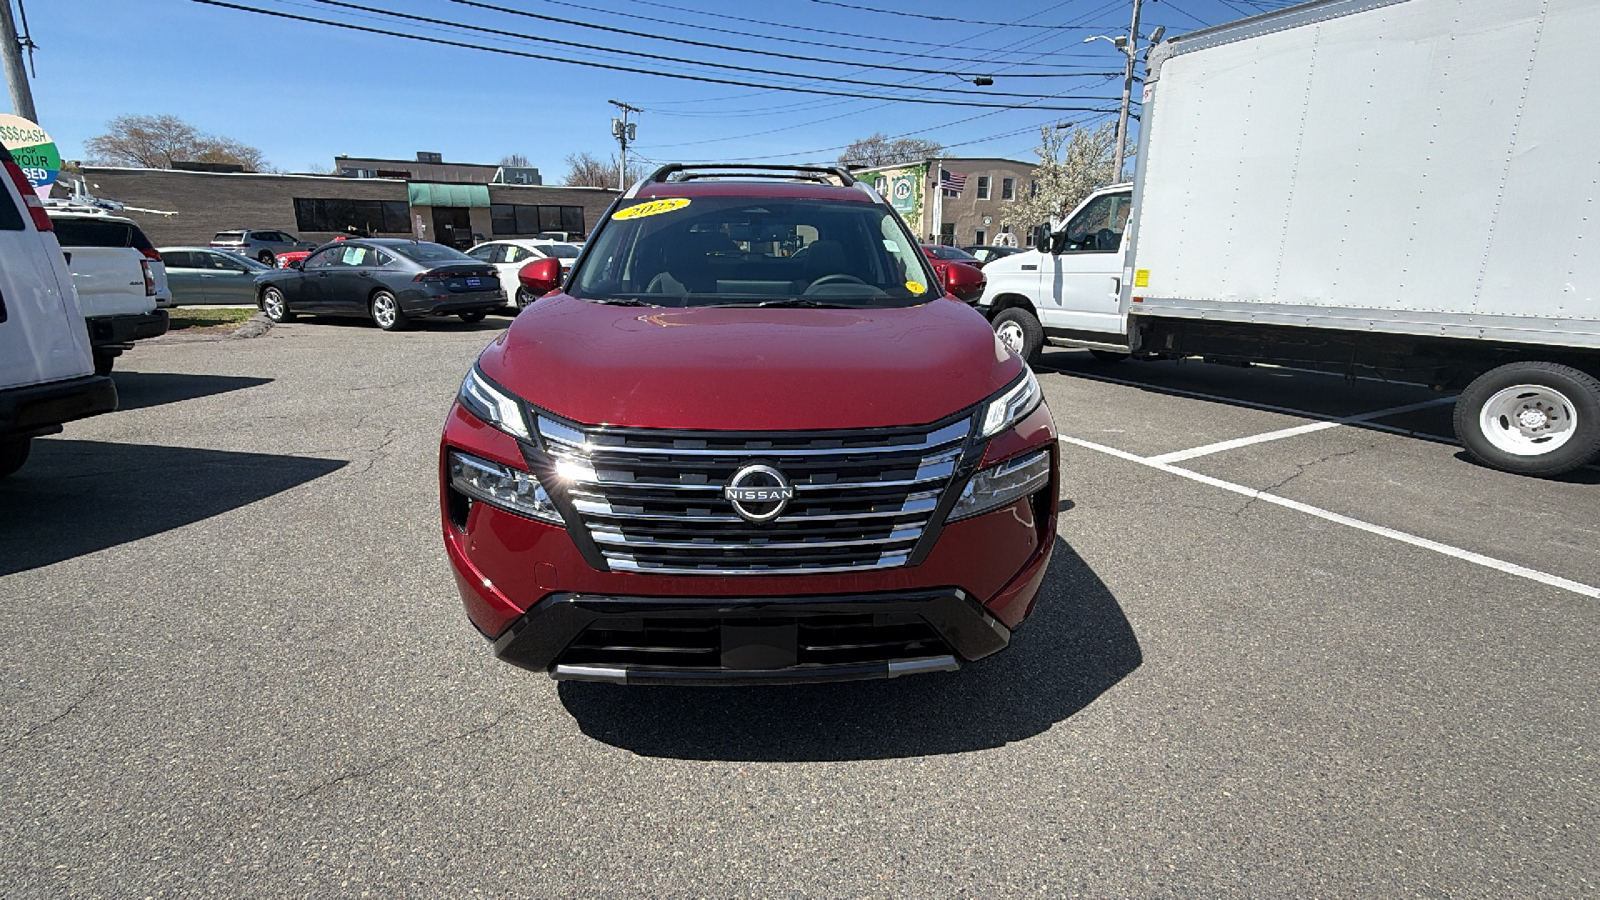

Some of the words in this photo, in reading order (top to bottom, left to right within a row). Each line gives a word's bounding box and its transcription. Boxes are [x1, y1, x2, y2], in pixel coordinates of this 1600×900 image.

[13, 155, 49, 167] YOUR
[22, 168, 48, 180] SED
[628, 200, 678, 217] 2025
[727, 489, 793, 500] NISSAN
